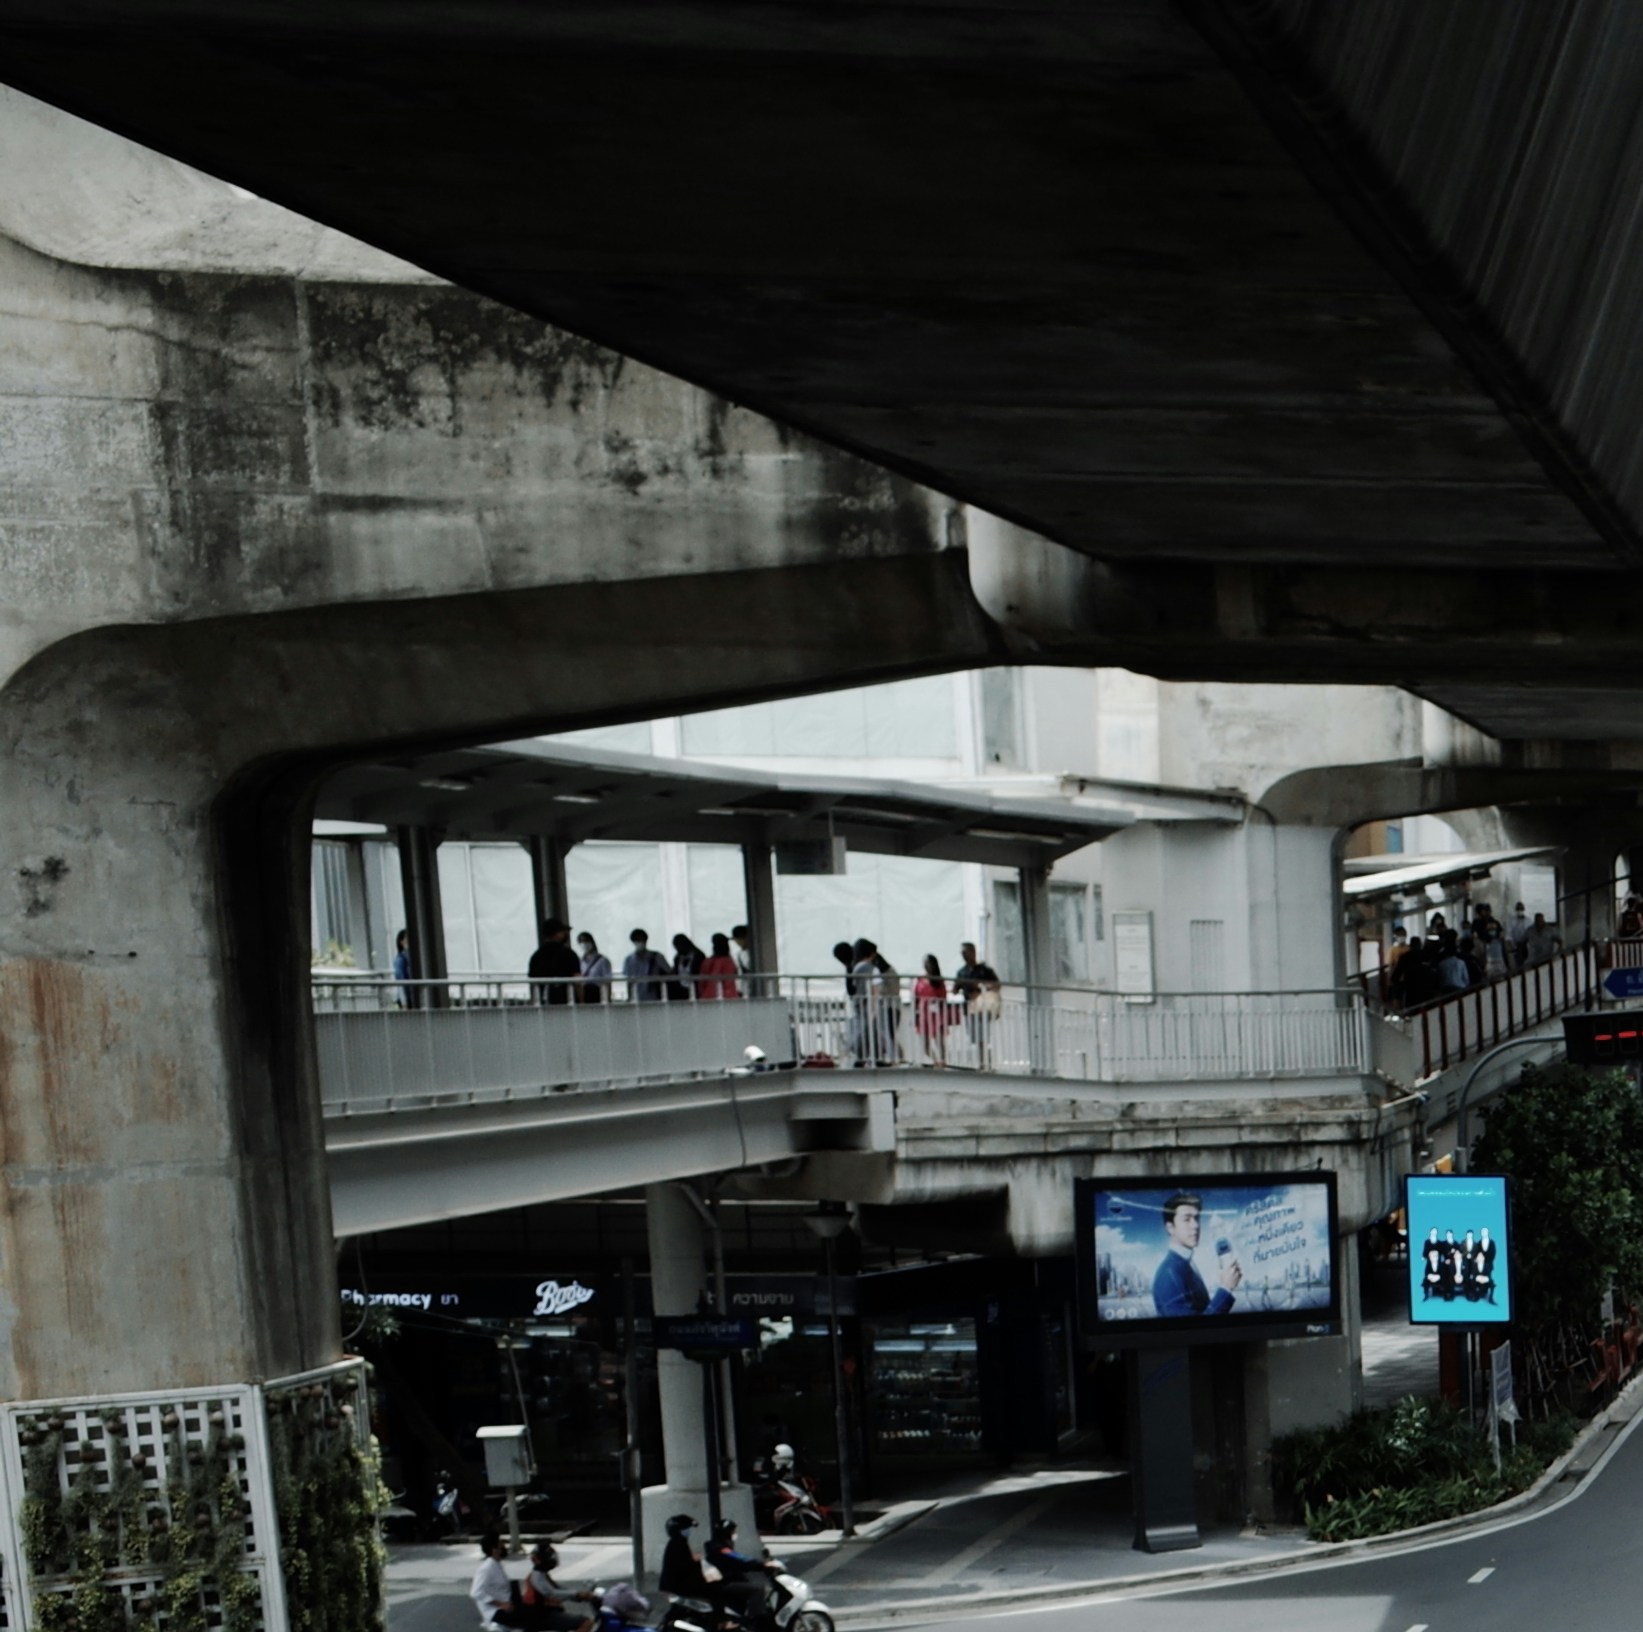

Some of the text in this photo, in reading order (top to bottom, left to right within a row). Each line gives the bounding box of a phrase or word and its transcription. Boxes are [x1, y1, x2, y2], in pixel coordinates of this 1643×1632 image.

[340, 1288, 432, 1310] Pharmacy
[441, 1293, 460, 1306] ยา
[531, 1279, 597, 1317] Boots
[732, 1291, 795, 1306] ความงาม
